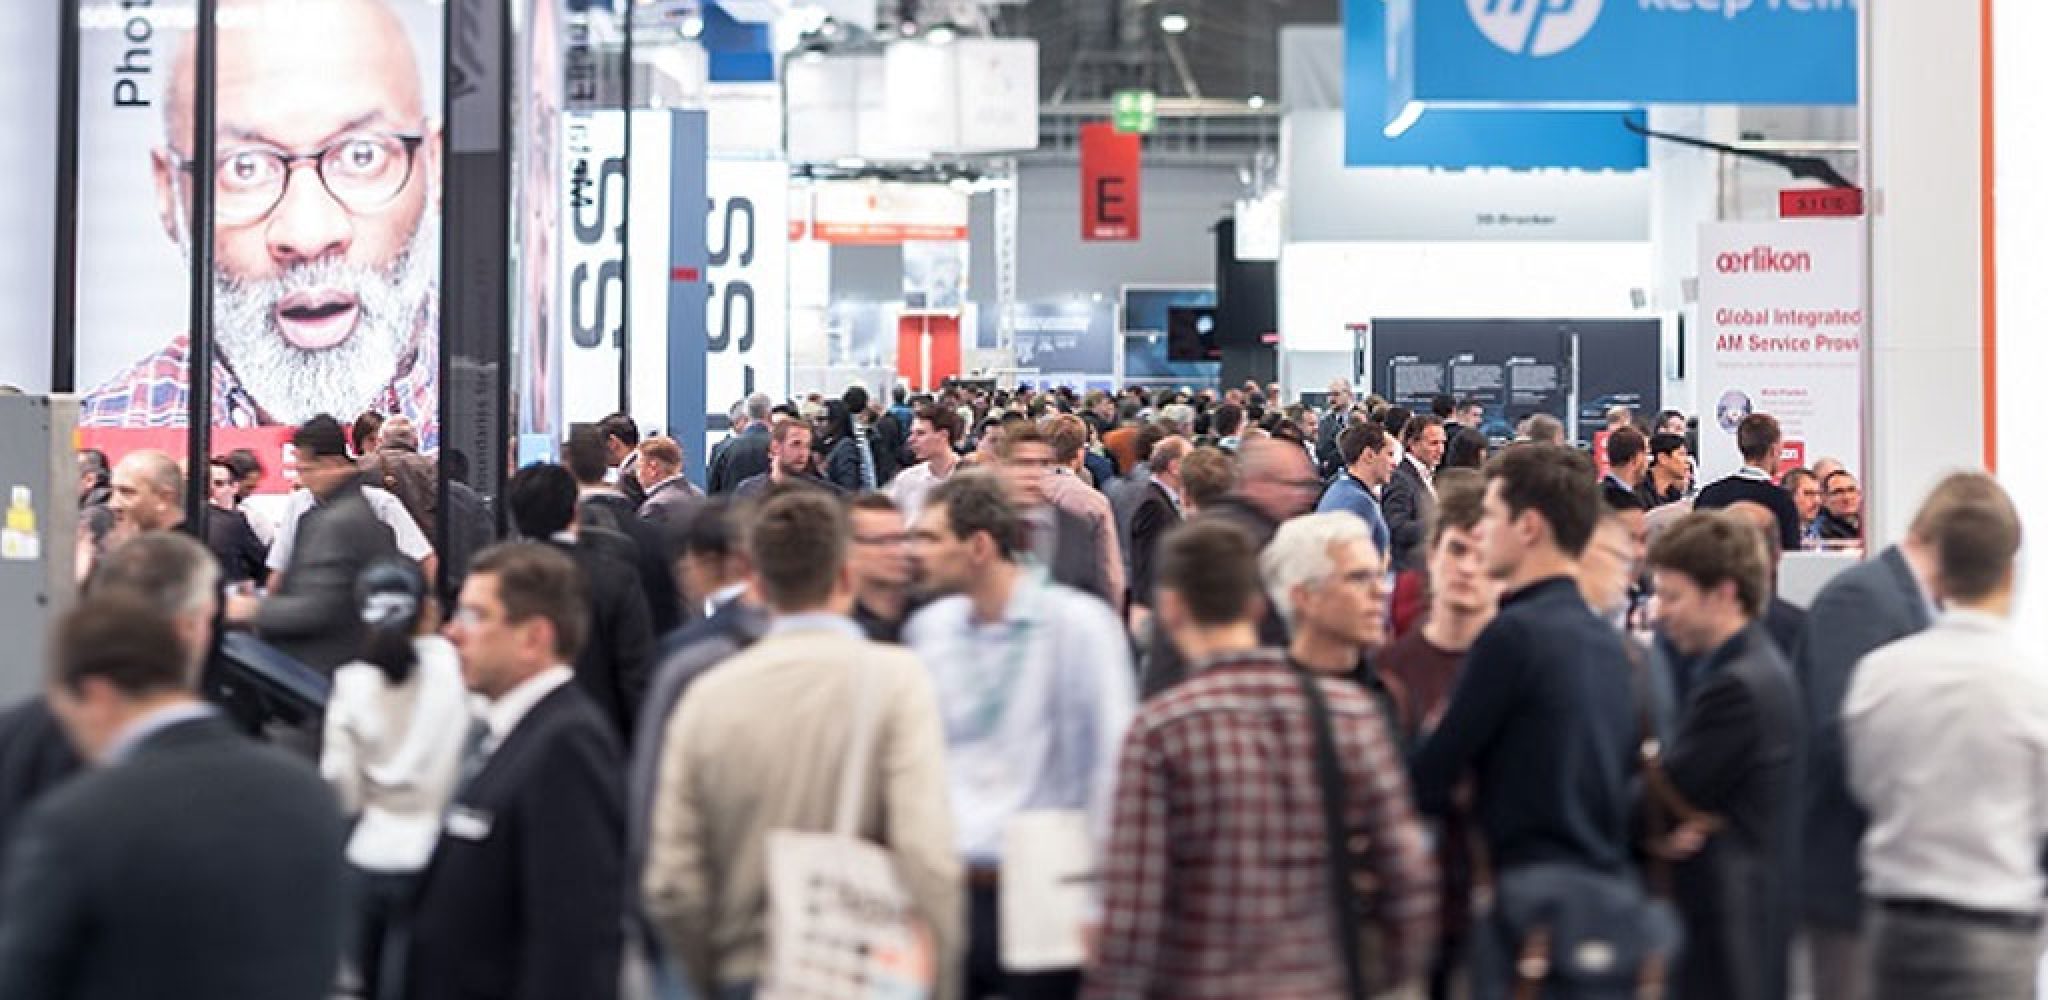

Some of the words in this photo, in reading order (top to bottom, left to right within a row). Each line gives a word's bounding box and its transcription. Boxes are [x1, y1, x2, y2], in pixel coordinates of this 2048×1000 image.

[1096, 177, 1125, 223] E
[1716, 307, 1769, 325] Global
[1773, 308, 1863, 328] Integrated
[1716, 334, 1743, 351] AM
[1748, 333, 1811, 351] Service
